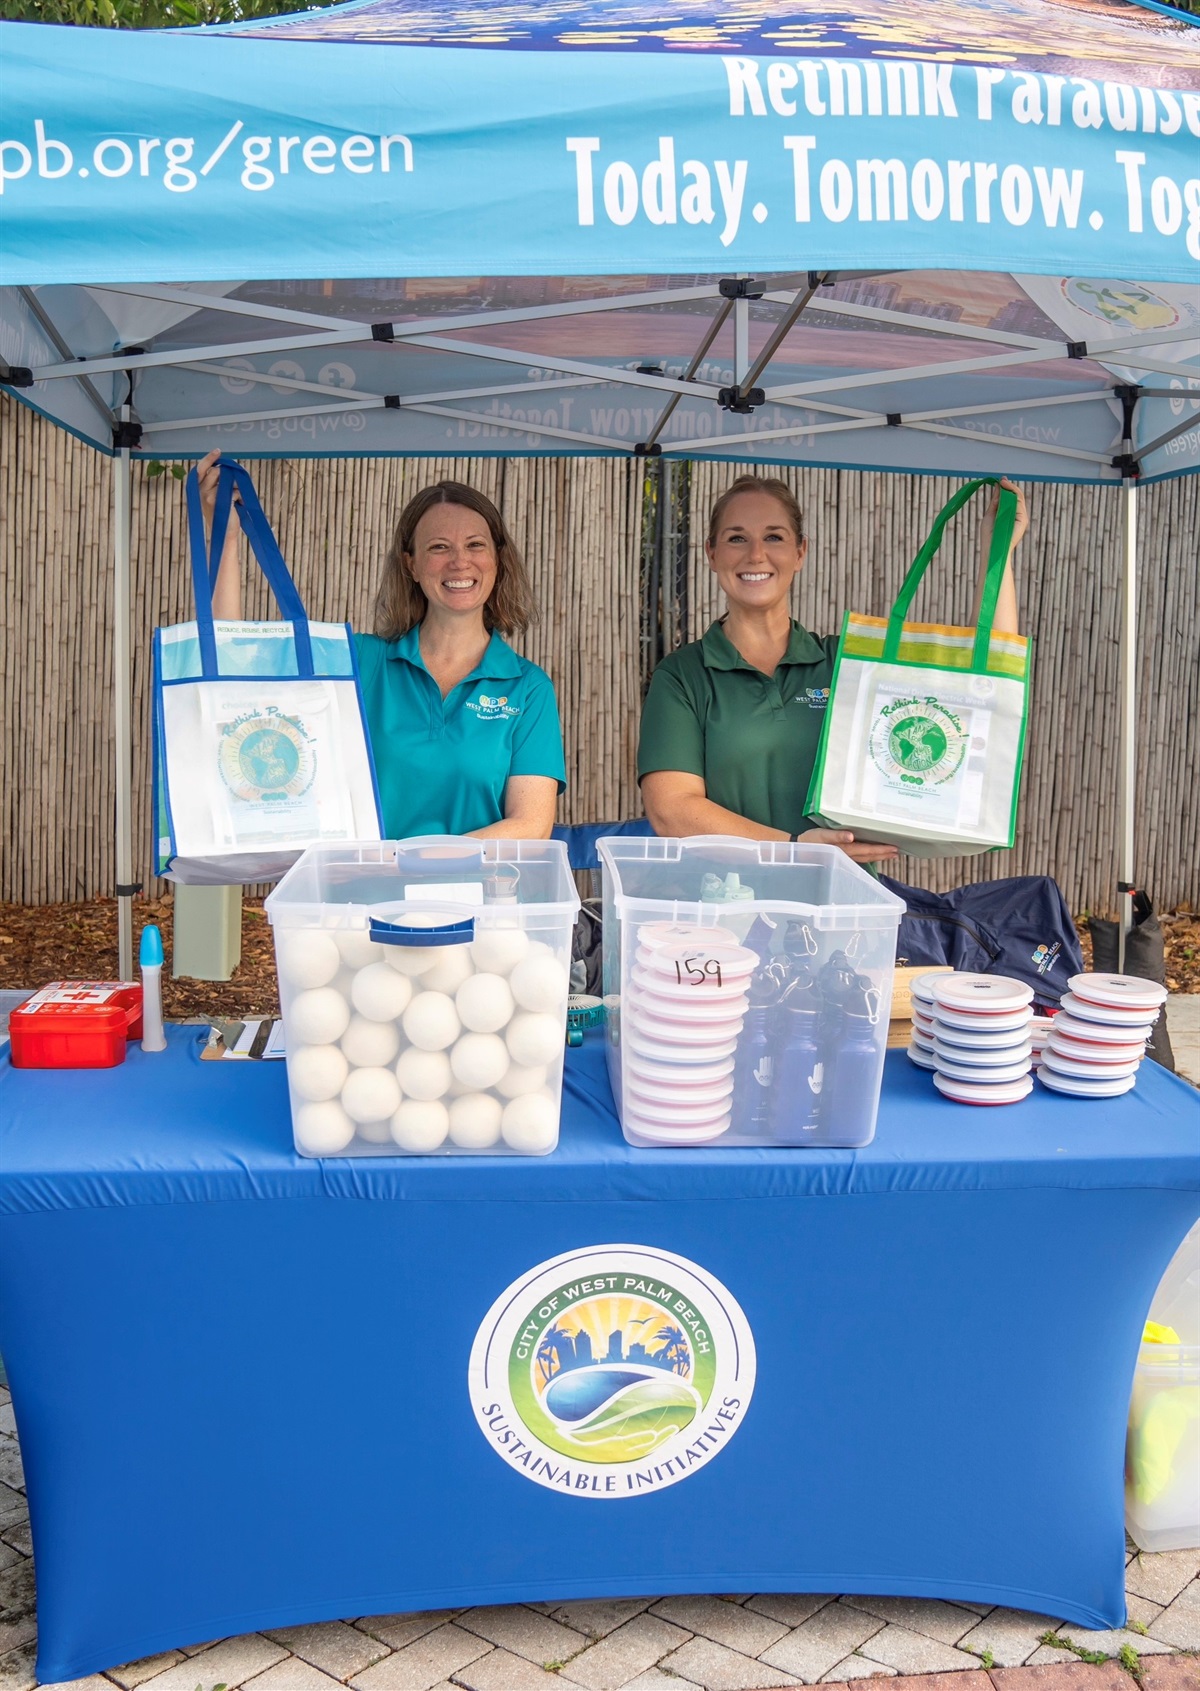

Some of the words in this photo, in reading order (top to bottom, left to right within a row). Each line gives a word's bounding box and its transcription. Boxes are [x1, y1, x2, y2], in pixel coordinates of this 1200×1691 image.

[721, 56, 958, 117] Rethink
[0, 119, 414, 193] pb.org/green
[566, 136, 768, 248] Today.
[783, 135, 1103, 231] Tomorrow.
[222, 708, 262, 737] Rethink
[465, 701, 481, 711] WEST
[501, 705, 520, 713] BEACH
[880, 696, 920, 717] Rethink
[674, 956, 723, 989] 159
[516, 1322, 540, 1360] CITY
[538, 1297, 560, 1318] OF
[562, 1277, 618, 1300] WEST
[623, 1277, 673, 1303] PALM
[673, 1299, 711, 1355] BEACH
[481, 1402, 616, 1493] SUSTAINABLE
[625, 1396, 742, 1490] INITIATIVES
